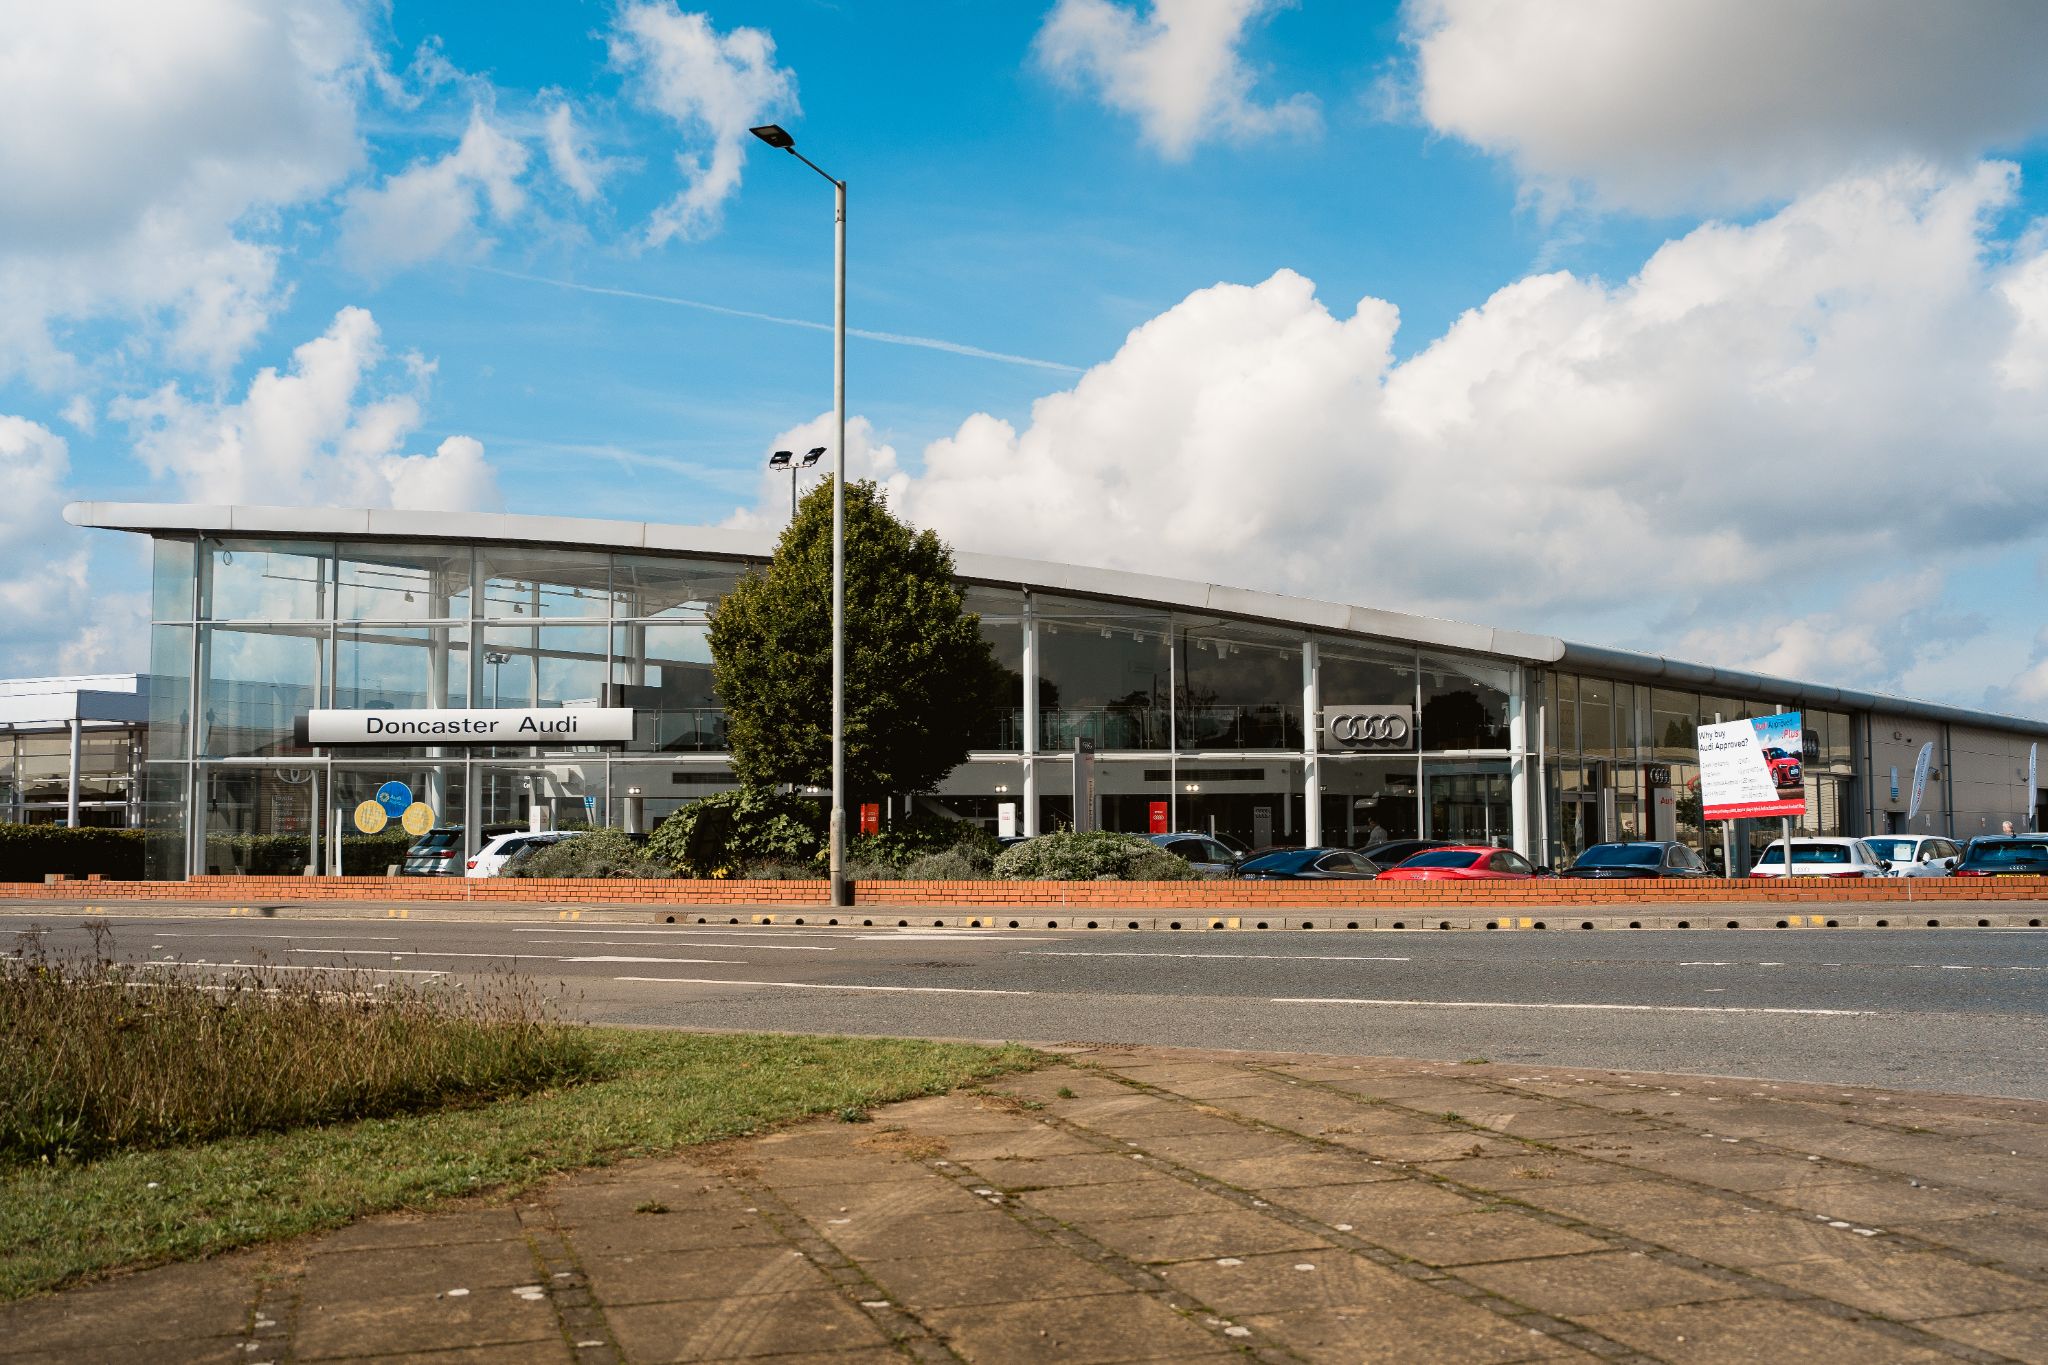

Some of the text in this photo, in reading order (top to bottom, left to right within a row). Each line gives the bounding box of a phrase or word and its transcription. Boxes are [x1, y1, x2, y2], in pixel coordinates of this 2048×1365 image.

[367, 715, 577, 734] Doncaster Audi
[1756, 718, 1793, 730] Audi Approved
[1698, 730, 1726, 741] Why buy
[1700, 738, 1748, 752] Audi Approved?
